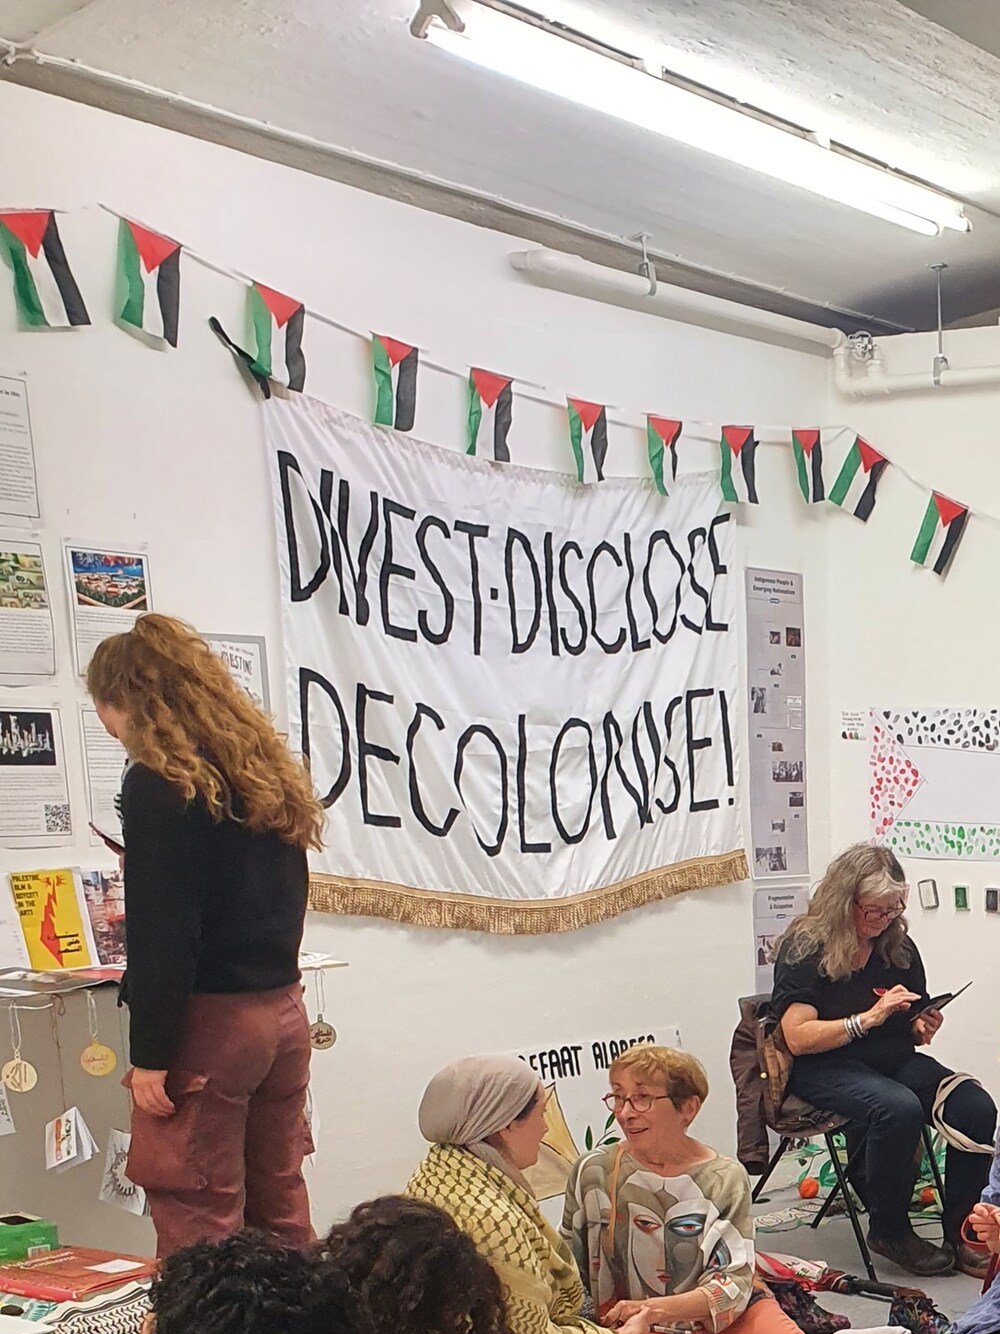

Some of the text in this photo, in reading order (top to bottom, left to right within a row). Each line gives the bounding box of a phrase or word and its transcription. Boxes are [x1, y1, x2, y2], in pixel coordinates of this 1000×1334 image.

[277, 449, 732, 657] DIVEST DISCLOSE
[299, 666, 736, 858] DECOLONISE!
[518, 1045, 583, 1081] EFAAT
